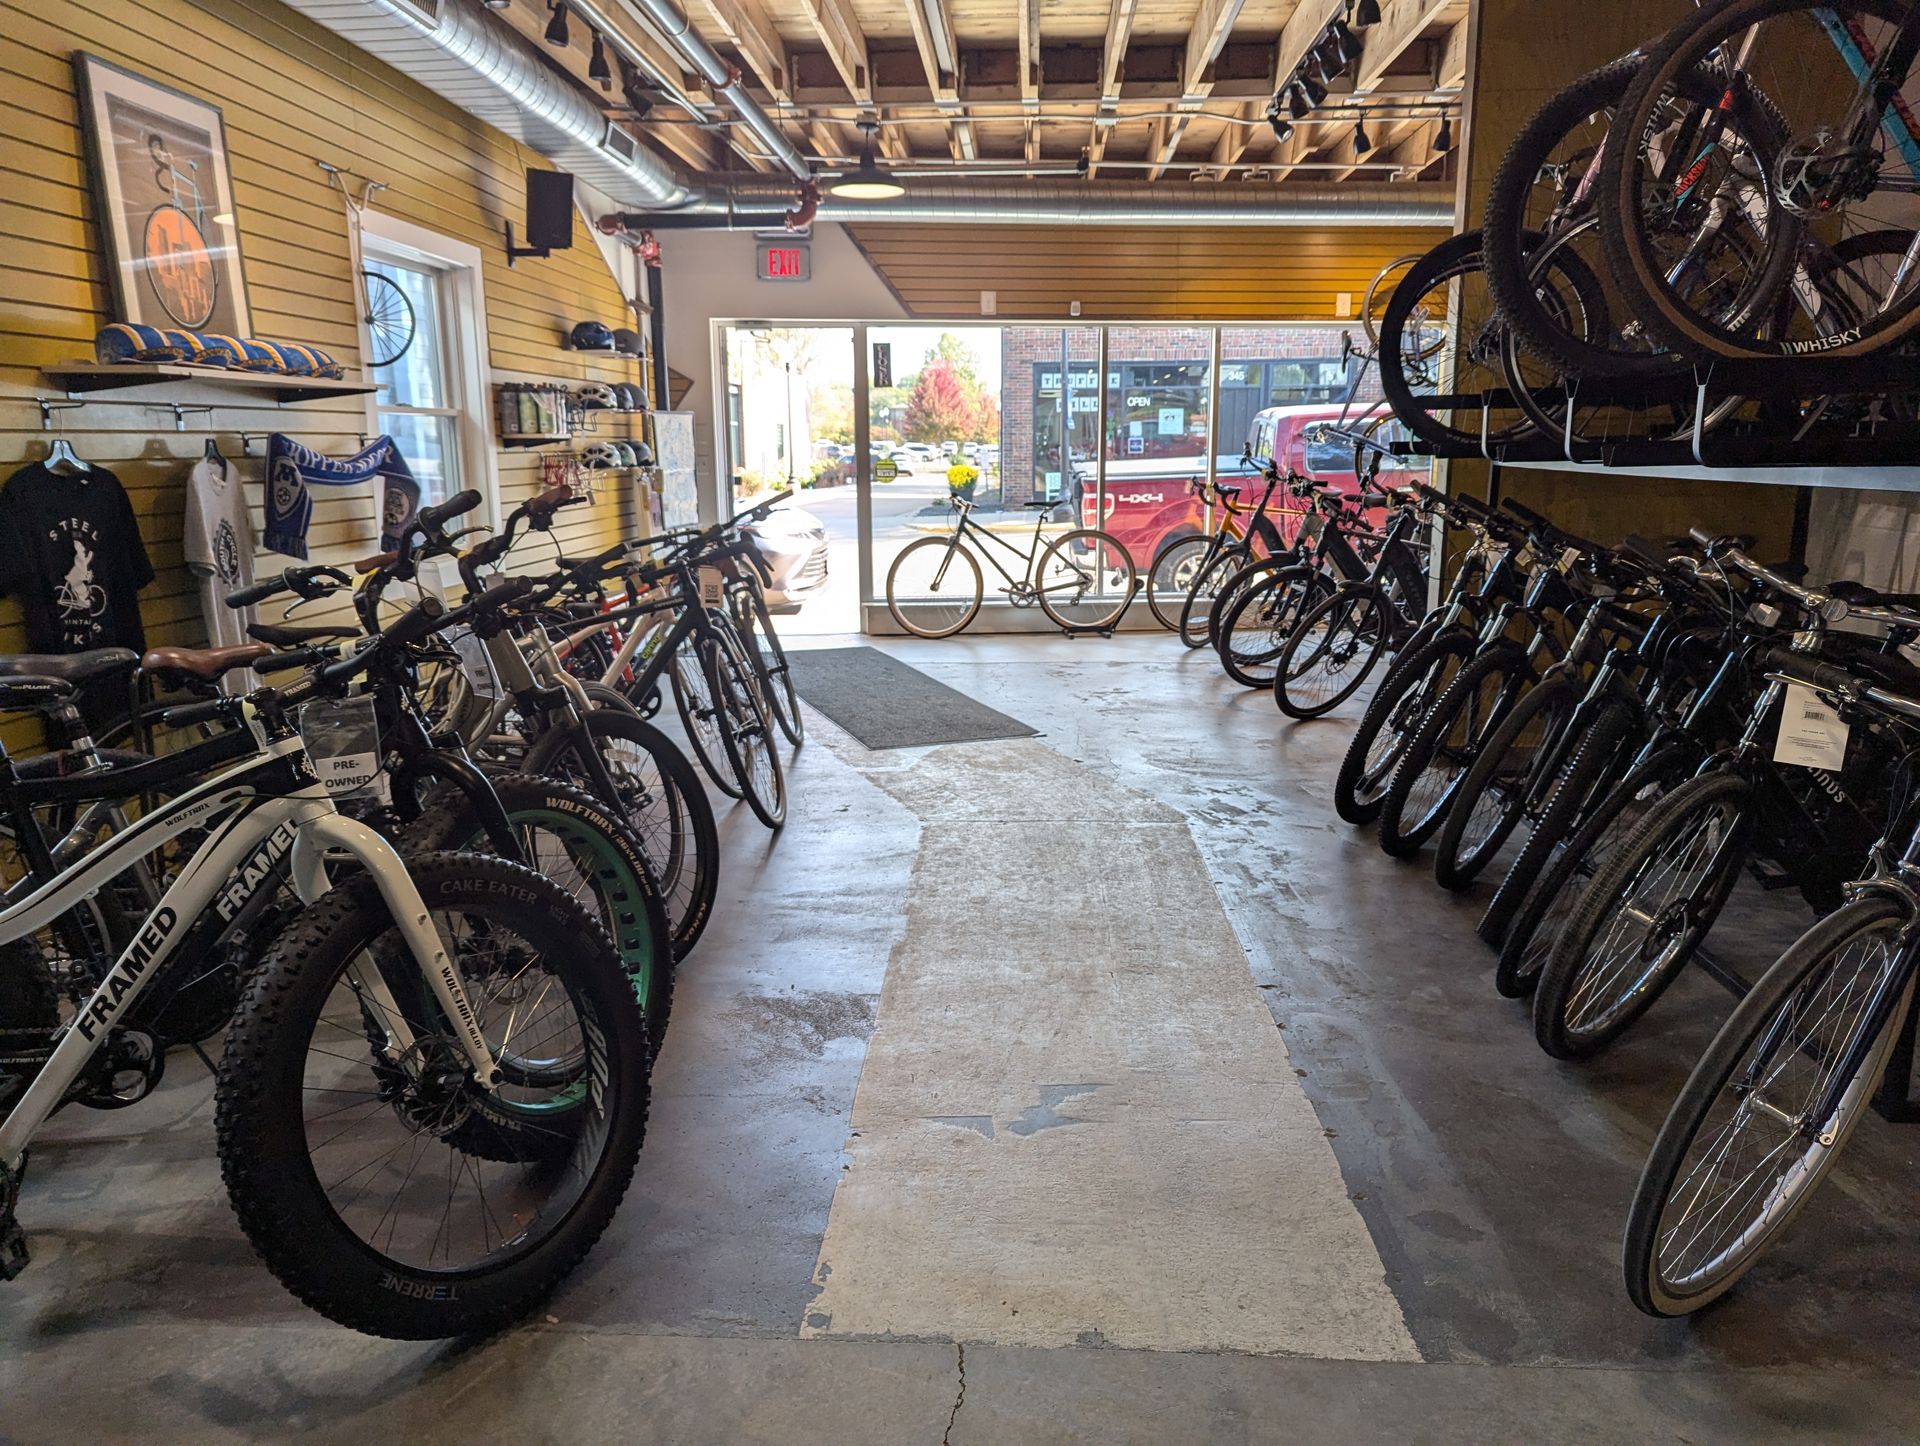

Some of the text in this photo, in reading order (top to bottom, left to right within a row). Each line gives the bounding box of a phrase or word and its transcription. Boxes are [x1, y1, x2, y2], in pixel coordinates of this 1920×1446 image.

[1637, 93, 1670, 161] WHISKY
[768, 248, 800, 276] EXIT
[1792, 327, 1864, 354] WHISKY
[1228, 370, 1246, 381] 345
[1127, 397, 1150, 407] OPEN
[1118, 492, 1164, 504] 4X4
[49, 517, 98, 541] STEEL
[284, 681, 312, 697] FRAMED
[333, 760, 360, 770] PRE-
[325, 774, 371, 788] OWNED
[165, 802, 210, 827] WOLFTRAX
[546, 797, 617, 834] WOLFTRAX
[440, 879, 538, 905] CAKE EATER
[77, 906, 177, 1042] FRAMED
[468, 1026, 484, 1050] ALLOY
[378, 1271, 460, 1301] TERRENE
